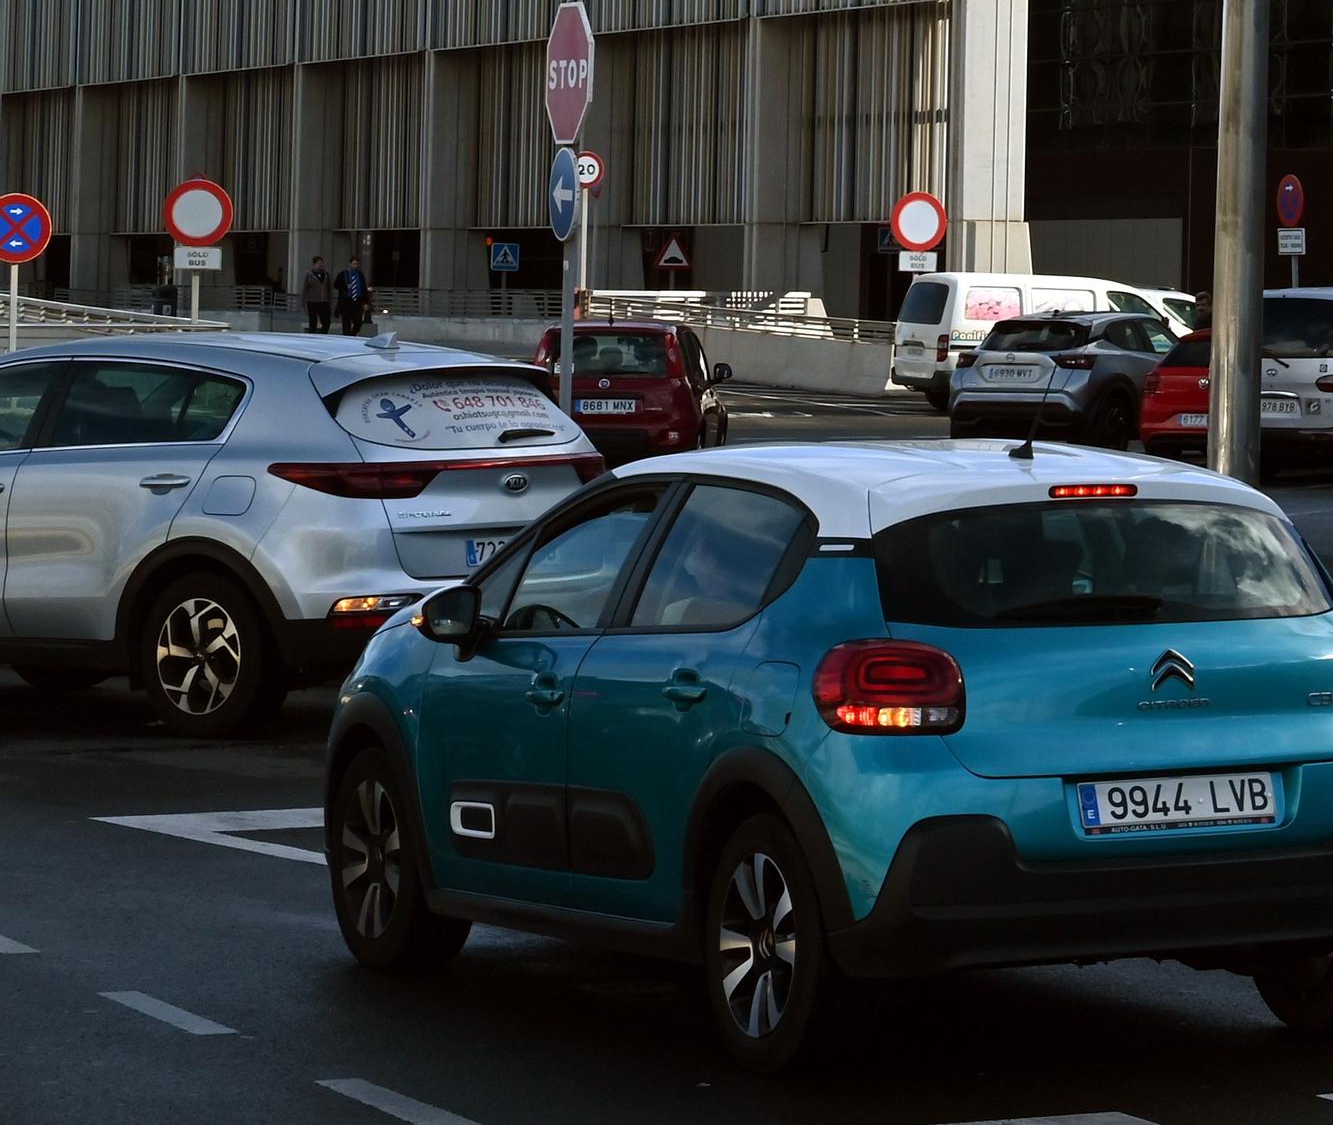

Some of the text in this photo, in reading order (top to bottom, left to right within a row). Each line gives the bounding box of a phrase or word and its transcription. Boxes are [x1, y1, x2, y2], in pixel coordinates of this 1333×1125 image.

[549, 59, 588, 91] STOP
[578, 163, 596, 176] 20
[951, 329, 990, 341] Panifi
[453, 396, 484, 410] 648
[485, 396, 516, 409] 701
[582, 401, 634, 411] 8681 MNX
[465, 422, 498, 433] cuerpo
[508, 475, 526, 490] KIA
[477, 540, 506, 562] 72
[1306, 691, 1333, 706] C3
[1087, 777, 1270, 820] E 9944 LVB
